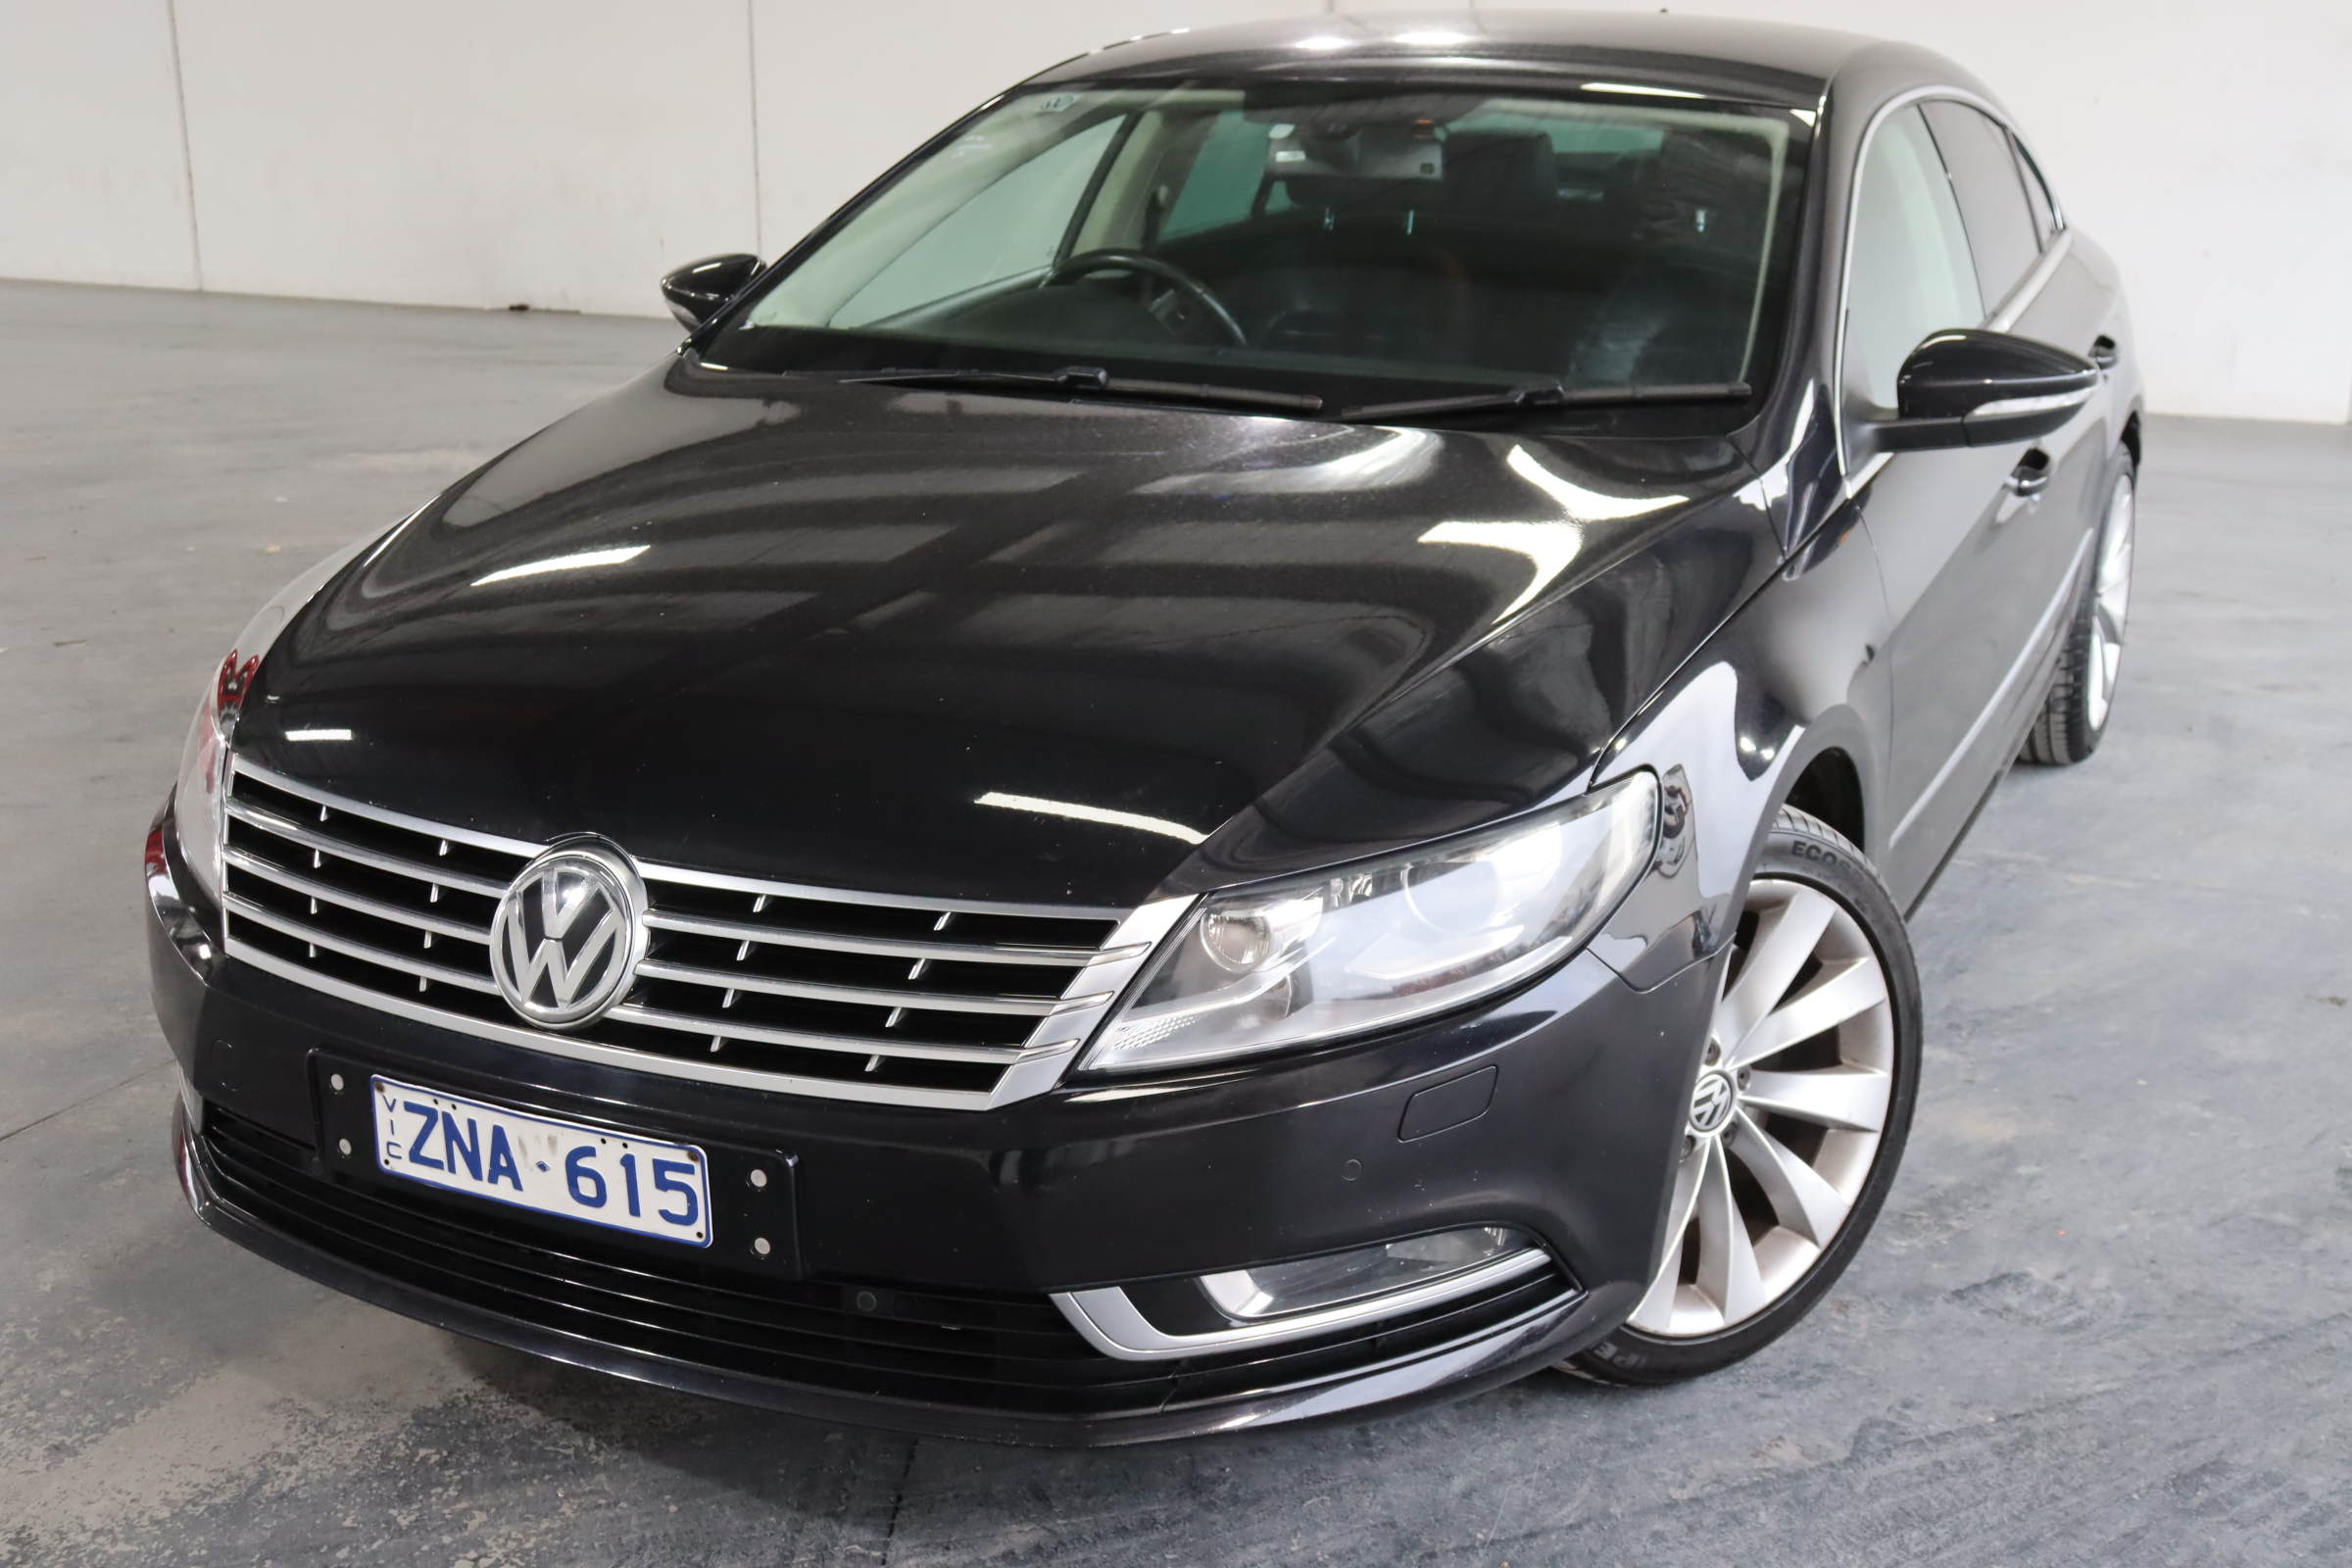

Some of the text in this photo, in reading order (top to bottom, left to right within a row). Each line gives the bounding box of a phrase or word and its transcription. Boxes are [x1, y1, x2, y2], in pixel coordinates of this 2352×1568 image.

[382, 1094, 402, 1159] VIC
[403, 1101, 699, 1227] ZNA 615
